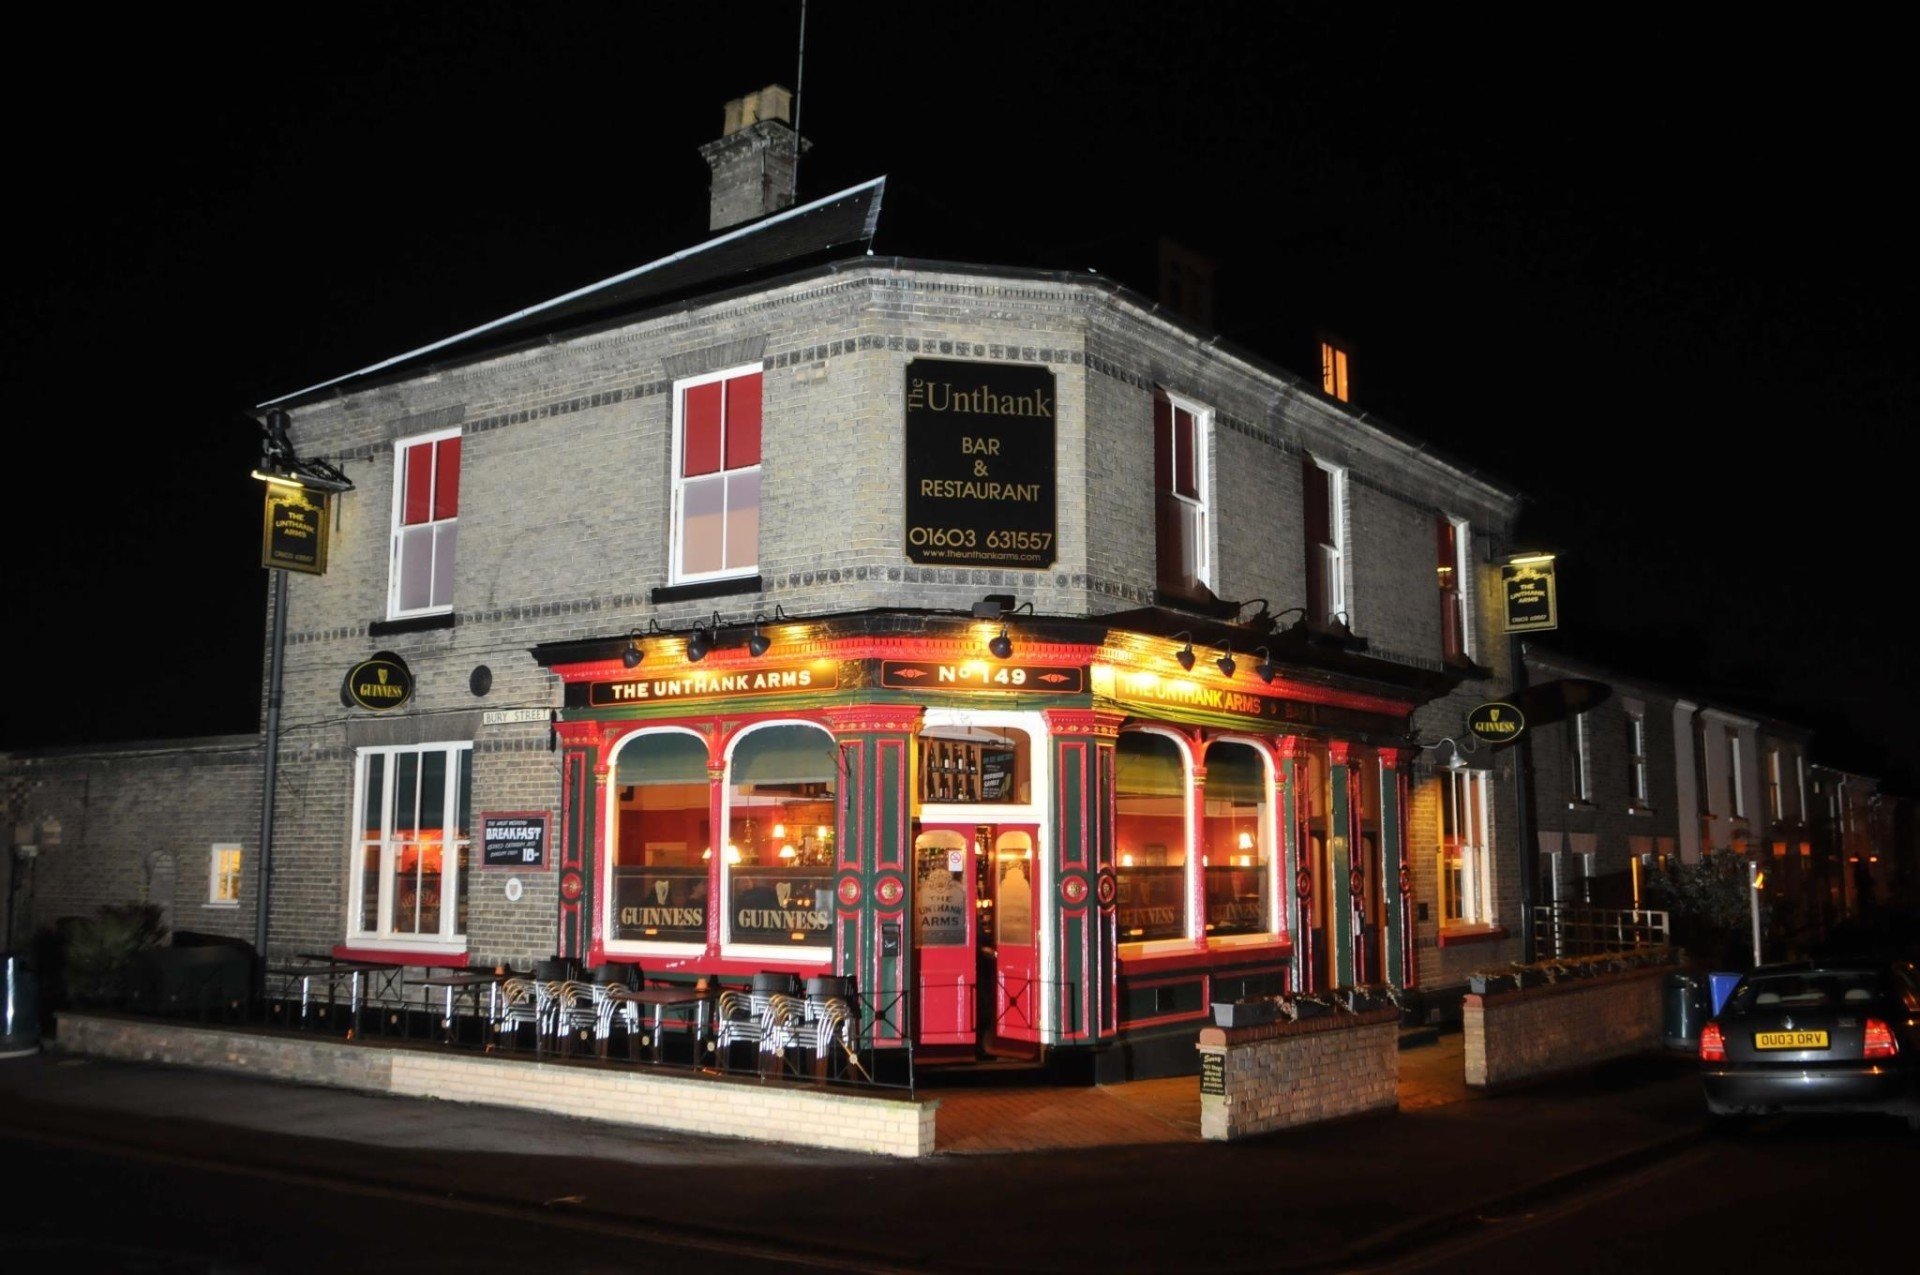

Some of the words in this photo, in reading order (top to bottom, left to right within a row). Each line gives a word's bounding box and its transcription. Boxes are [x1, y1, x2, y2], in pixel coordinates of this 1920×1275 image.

[908, 378, 924, 412] The
[926, 382, 1053, 417] Unthank
[962, 436, 1000, 455] BAR
[974, 460, 989, 477] &
[921, 479, 1040, 502] RESTAURANT
[909, 527, 976, 547] 01603
[986, 531, 1052, 550] 631557
[922, 549, 1041, 562] www.theunthankarms.com
[979, 664, 1027, 685] 149
[359, 684, 402, 698] GUINNESS
[612, 682, 649, 699] THE
[654, 675, 749, 697] UNTHANK
[753, 670, 811, 689] ARMS
[1224, 693, 1261, 714] ARMS
[486, 711, 508, 723] BURY
[514, 709, 546, 721] STREET
[1475, 721, 1515, 732] GUINNESS
[486, 827, 542, 840] BREAKFAST
[621, 907, 703, 926] GUINNESS
[738, 908, 828, 930] GUINNESS
[922, 916, 959, 927] ARMS
